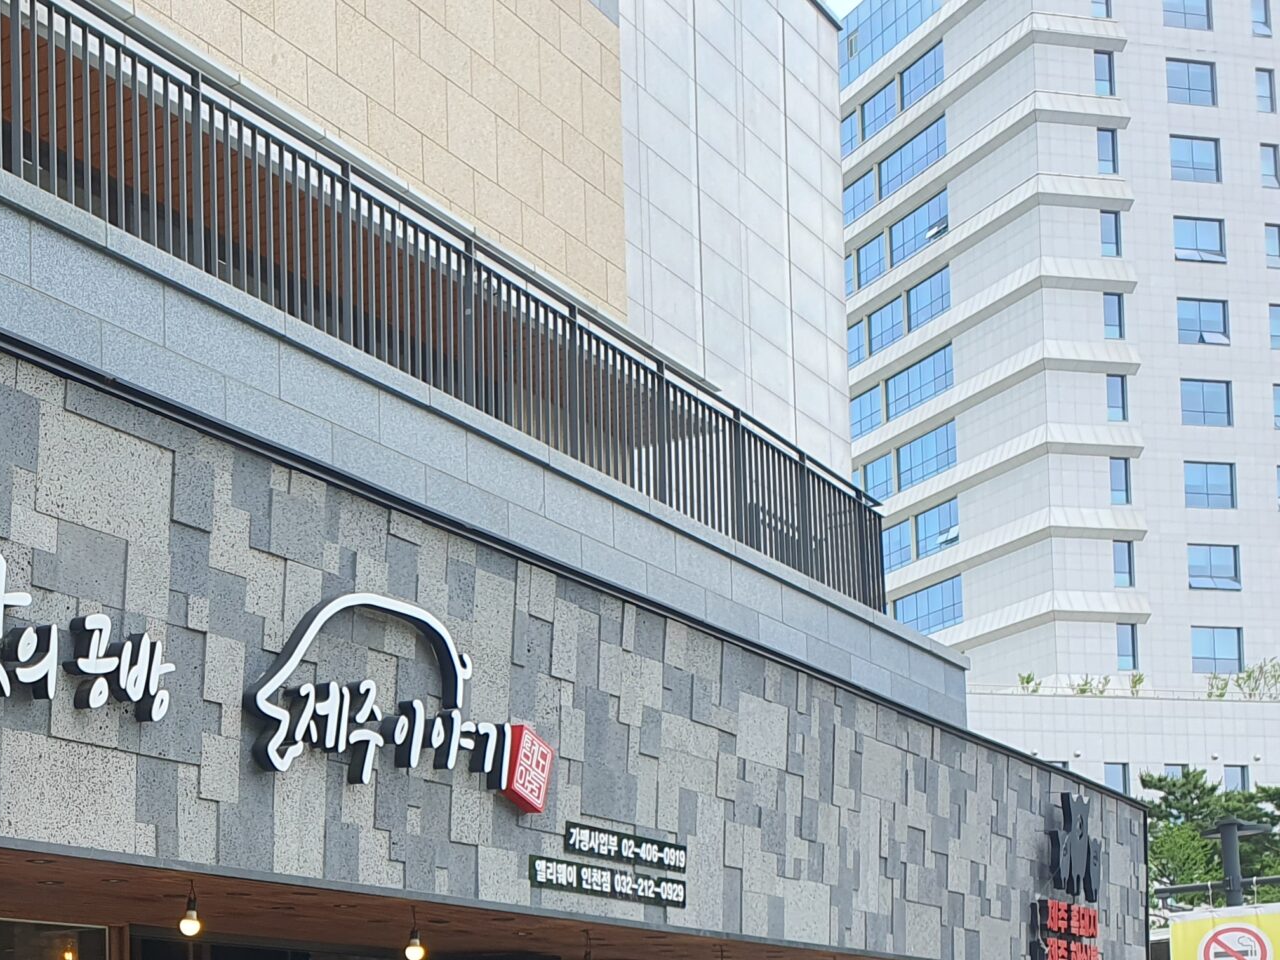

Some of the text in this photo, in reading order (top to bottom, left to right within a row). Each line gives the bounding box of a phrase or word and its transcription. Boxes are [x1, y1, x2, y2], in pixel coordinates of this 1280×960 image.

[569, 827, 686, 868] 가맹사업부 02-406-0919
[581, 867, 611, 892] 인천점
[614, 873, 684, 902] 032-212-0929
[1047, 899, 1068, 929] 제주
